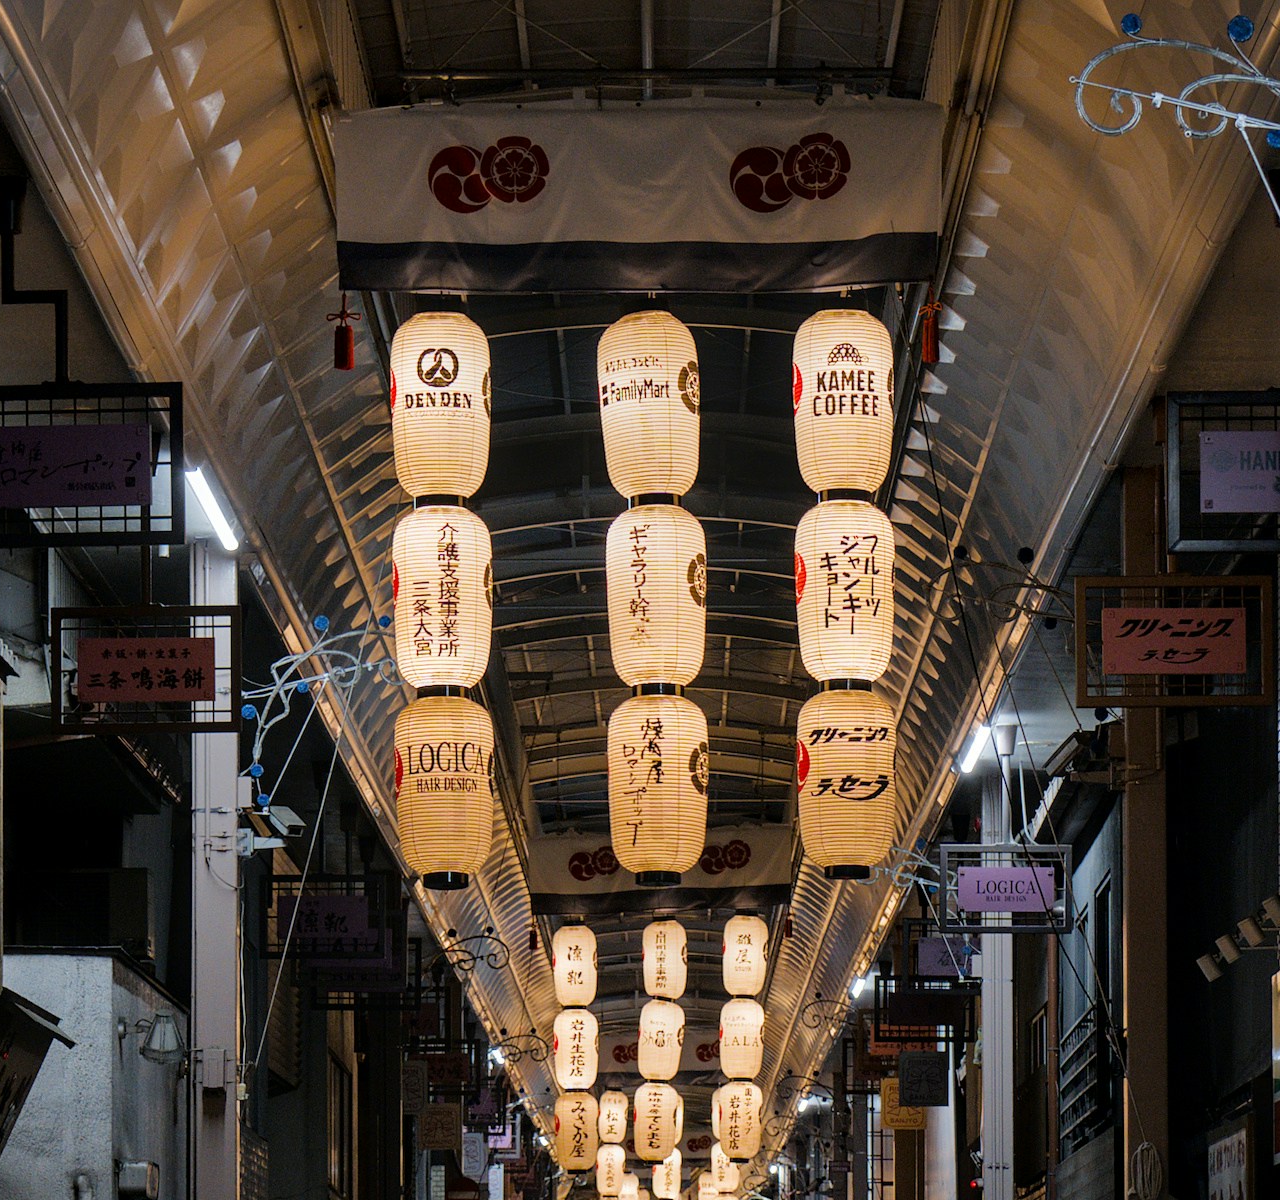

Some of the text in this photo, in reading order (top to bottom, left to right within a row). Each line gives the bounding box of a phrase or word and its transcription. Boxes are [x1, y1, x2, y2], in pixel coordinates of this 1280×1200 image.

[610, 378, 670, 403] FamilyMart
[816, 369, 876, 392] KAMEE
[404, 392, 473, 409] DEN DEN
[813, 394, 879, 417] COFFEE
[0, 452, 142, 486] ロマンポップ
[437, 522, 460, 657] 介護支援事業所
[819, 552, 840, 628] キョート
[839, 534, 862, 635] ジャンキー
[861, 534, 881, 617] フルーツ
[412, 581, 433, 657] 三条大宮
[1116, 618, 1234, 638] クリーニング
[86, 666, 206, 691] 三条鳴海餅
[640, 717, 665, 785] 焼肉屋
[808, 726, 890, 746] クリーニング
[407, 742, 485, 776] LOGICA
[416, 778, 478, 793] HAIR DESIGN
[622, 743, 647, 847] ロマンポップ
[976, 880, 1037, 895] LOGICA
[570, 1019, 586, 1078] 岩井生花店
[723, 1035, 760, 1048] LALA
[569, 1101, 589, 1158] みさか屋
[728, 1095, 741, 1151] 岩井花店
